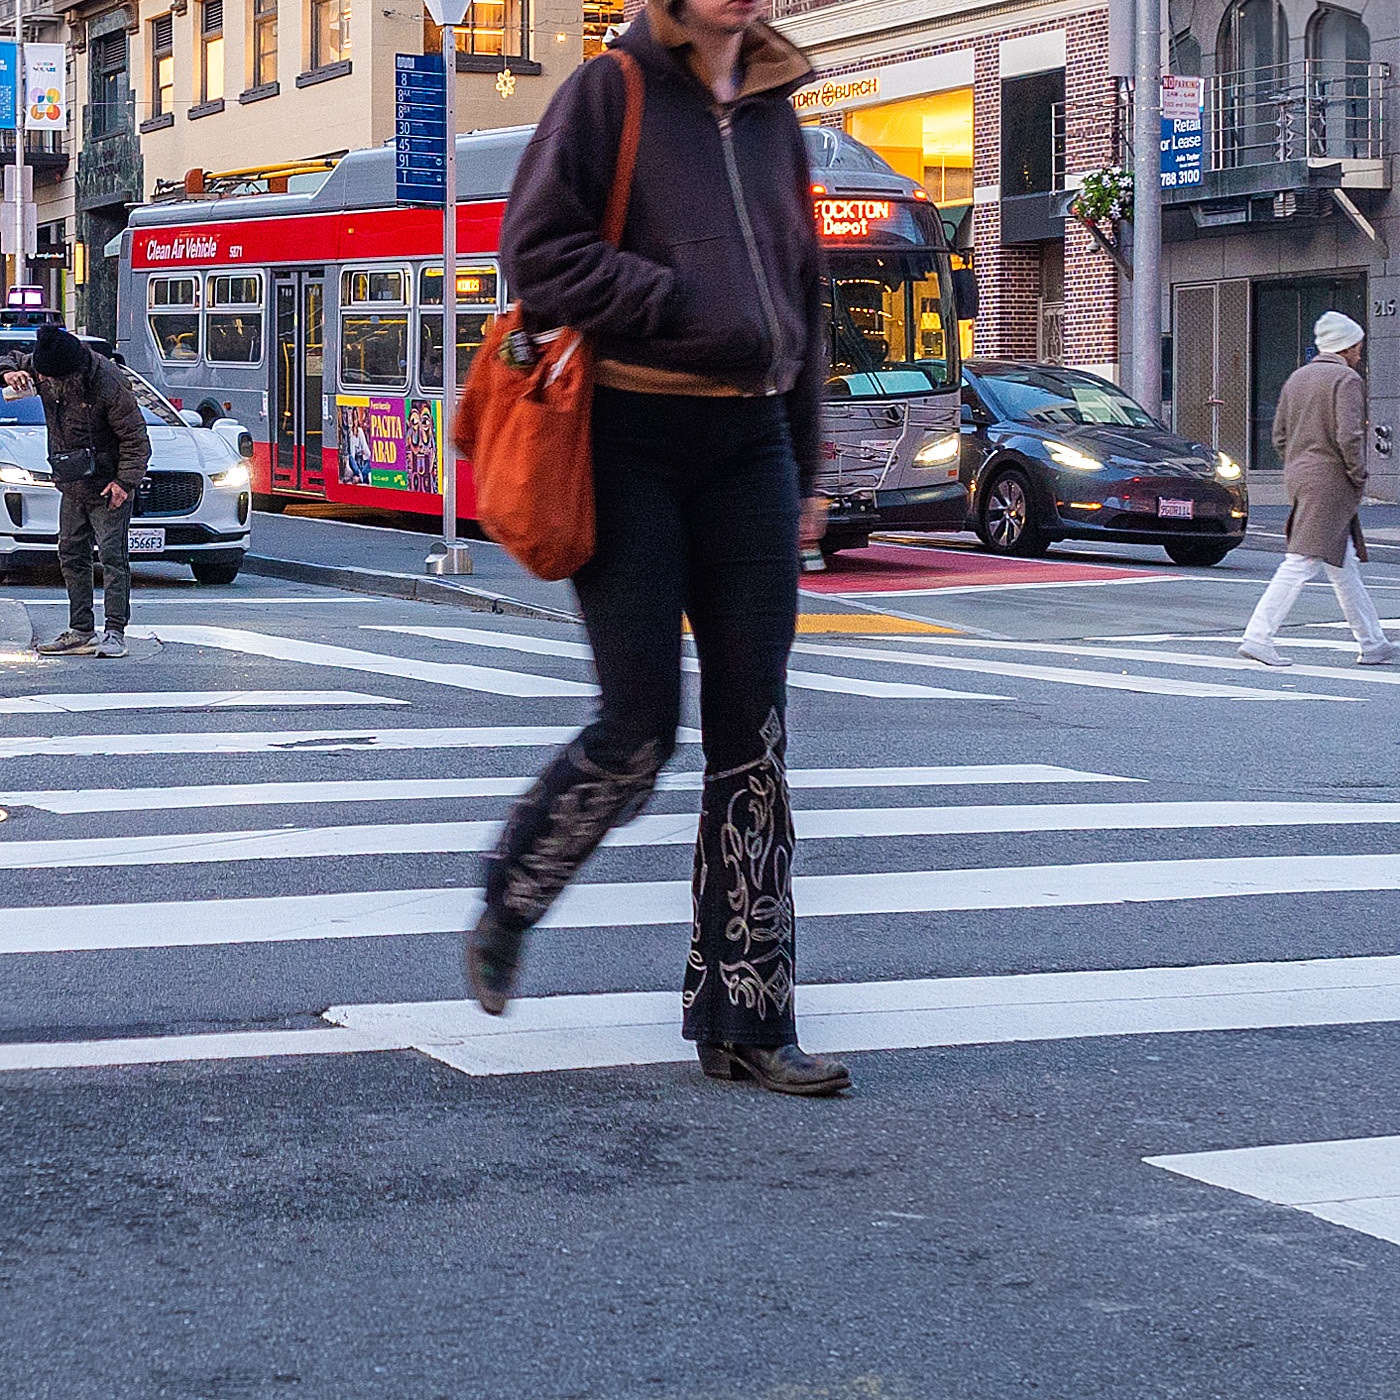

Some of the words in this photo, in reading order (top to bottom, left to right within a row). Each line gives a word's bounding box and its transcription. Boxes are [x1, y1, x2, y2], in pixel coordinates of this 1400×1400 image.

[400, 73, 408, 86] 8
[1163, 76, 1174, 89] NO
[792, 89, 821, 108] TORY
[835, 78, 877, 99] BURCH
[399, 121, 410, 135] 30
[1173, 119, 1201, 133] Retail
[399, 138, 410, 152] 45
[1172, 134, 1201, 150] Lease
[399, 154, 409, 167] 91
[402, 170, 408, 183] T
[1160, 171, 1177, 186] 788
[1178, 169, 1200, 185] 3100
[823, 217, 868, 236] Depot
[147, 239, 171, 261] Clean
[170, 238, 185, 259] Air
[185, 236, 217, 259] Vehicle
[371, 440, 397, 464] ABAD
